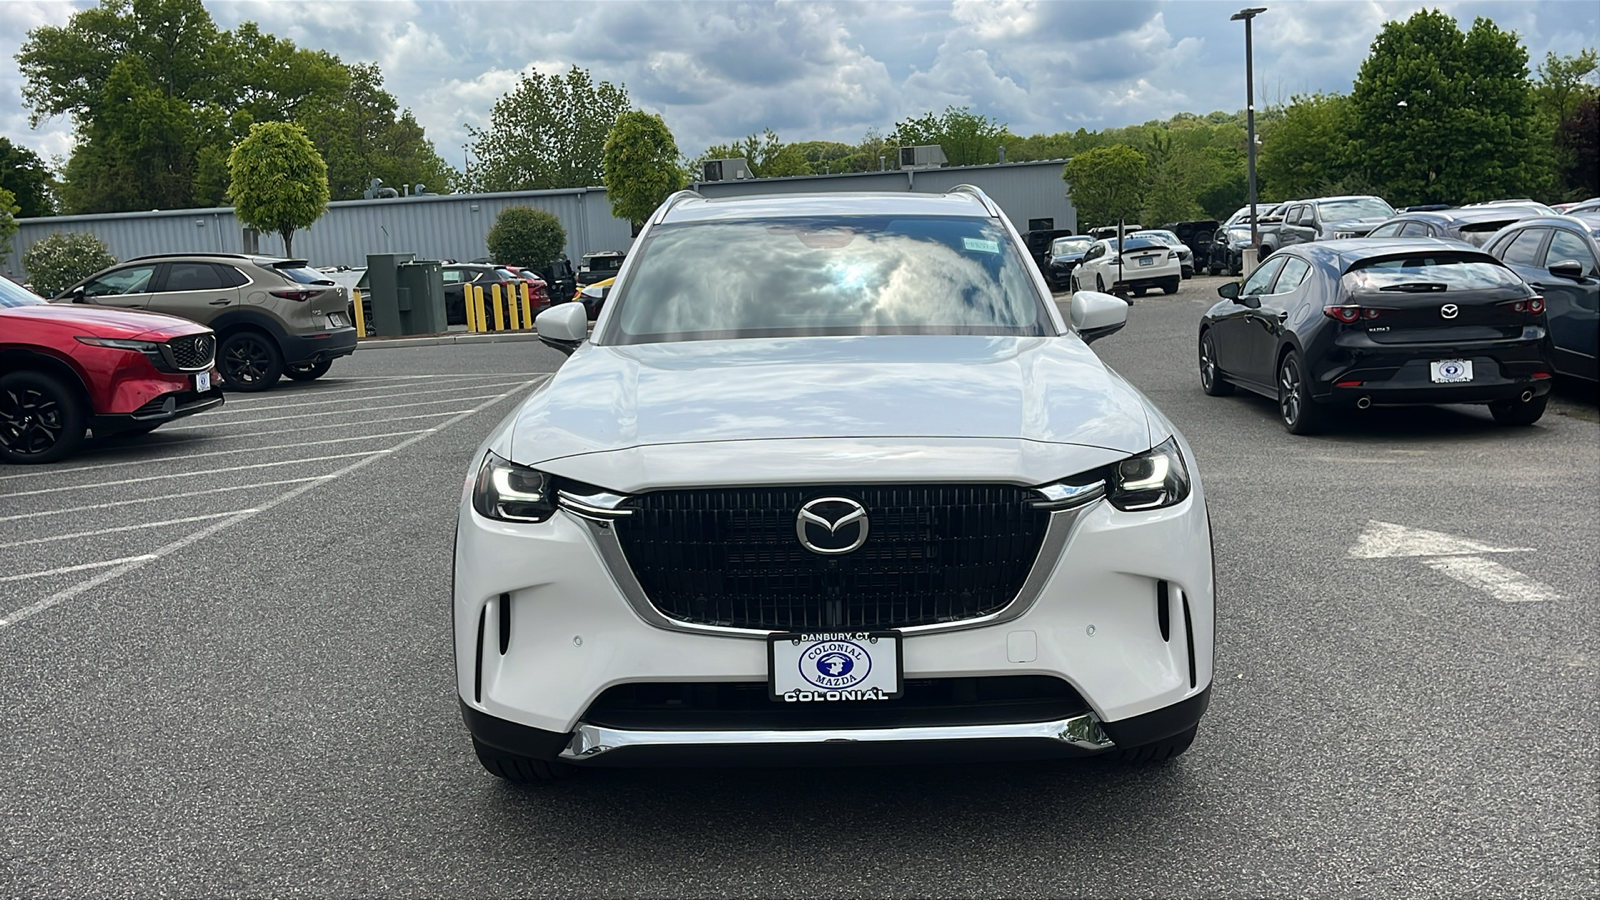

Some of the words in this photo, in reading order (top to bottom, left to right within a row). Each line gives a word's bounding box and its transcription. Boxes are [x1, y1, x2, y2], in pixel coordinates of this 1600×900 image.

[856, 632, 870, 640] CT
[808, 643, 862, 661] COLONIAL
[815, 674, 857, 686] MAZDA
[784, 690, 889, 702] COLONIAL
